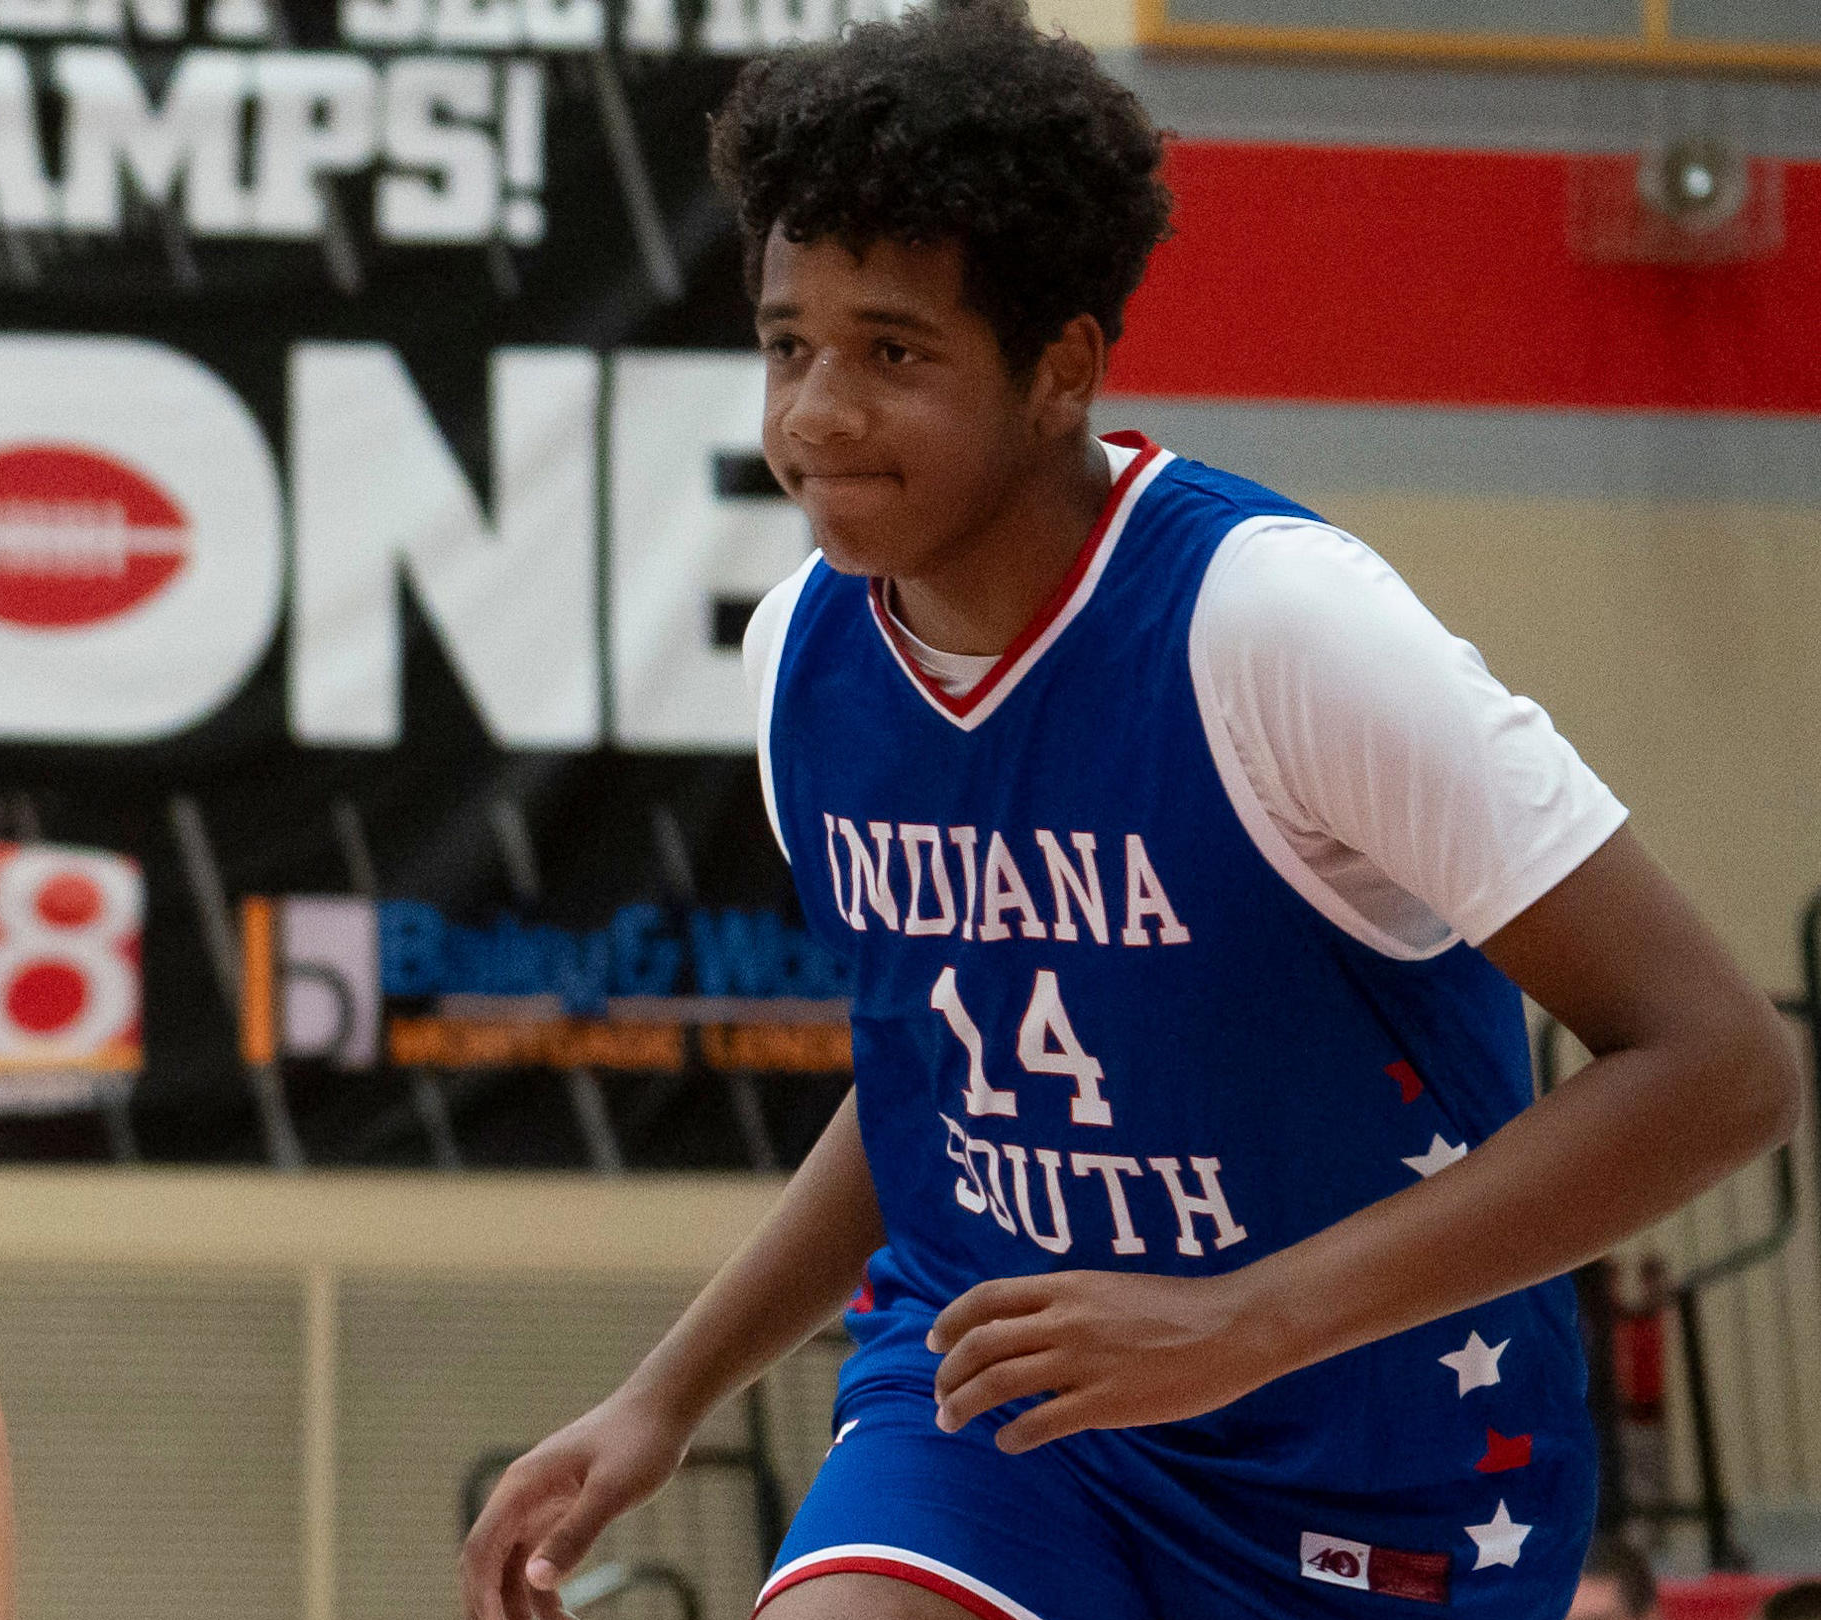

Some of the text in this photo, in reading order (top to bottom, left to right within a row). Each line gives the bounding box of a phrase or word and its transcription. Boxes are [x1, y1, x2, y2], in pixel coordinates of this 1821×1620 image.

[823, 811, 1192, 947] INDIANA
[930, 966, 1114, 1127] 14
[938, 1111, 1249, 1257] SOUTH
